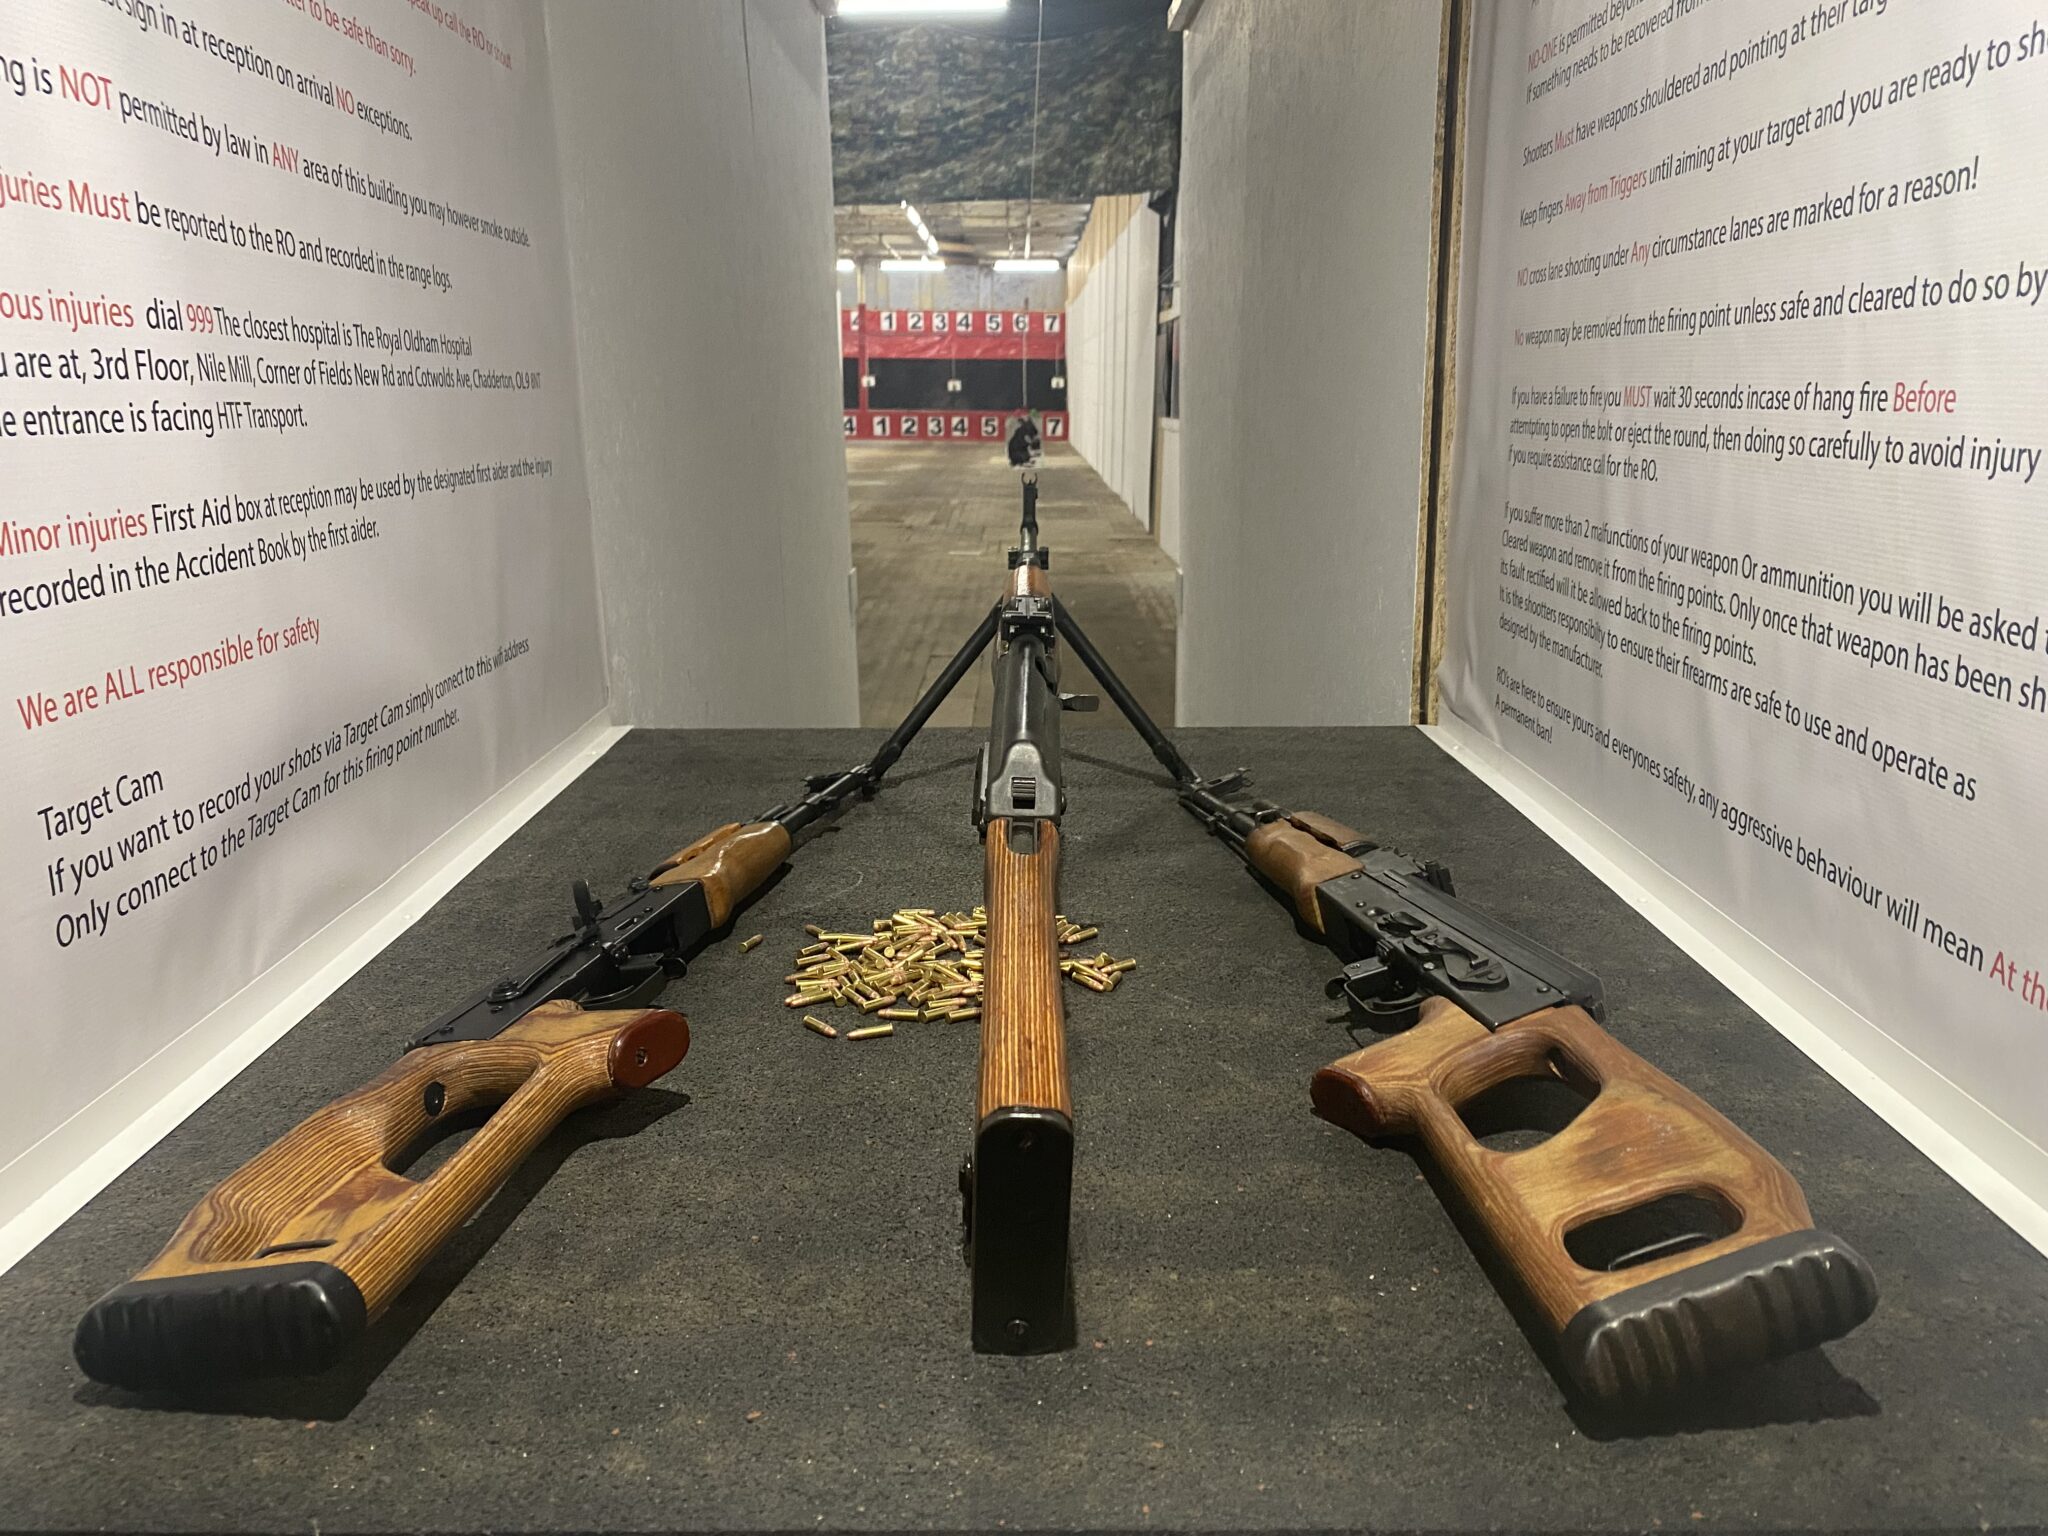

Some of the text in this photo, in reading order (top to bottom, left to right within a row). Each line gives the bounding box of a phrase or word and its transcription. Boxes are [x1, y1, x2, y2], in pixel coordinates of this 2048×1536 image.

[160, 4, 334, 107] in at arrival
[309, 2, 322, 21] to
[365, 26, 388, 58] than
[432, 3, 471, 44] up the
[1528, 9, 1608, 73] NO-ONE permitted
[1600, 3, 1673, 62] to recovered
[1598, 2, 1848, 132] weapons pointing at their
[32, 58, 427, 216] is NOT permitted by law area you
[1564, 40, 2010, 214] Away at and you are ready to
[68, 180, 431, 289] Must be reported to and range
[1548, 156, 1979, 280] lane circumstance marked for a reason!
[48, 289, 374, 348] injuries dial 999 The The
[885, 315, 893, 328] 1
[911, 315, 922, 328] 2
[935, 315, 945, 328] 3
[959, 314, 971, 329] 4
[989, 315, 999, 329] 5
[1016, 314, 1026, 329] 6
[1046, 315, 1058, 329] 7
[1554, 269, 2009, 347] may point and cleared to do so
[15, 348, 472, 390] are at, 3rd Floor, Nile of Ave,
[1602, 380, 1956, 419] you seconds of hang fire Before
[24, 402, 242, 436] entrance HTF
[845, 418, 1061, 434] 4 1 2 3 4 5 7
[1582, 418, 2042, 484] the round, so carefully to avoid injury
[1607, 454, 1658, 482] for RO.
[66, 471, 432, 552] injuries First Aid box at may the
[0, 526, 327, 616] recorded in the the
[1584, 520, 2038, 651] 2 weapon you will be asked
[1552, 641, 1602, 678] manufacturer.
[1558, 547, 2011, 702] and firing once that weapon has been
[1624, 597, 1756, 666] back the firing points.
[17, 628, 279, 730] We are for
[1500, 700, 1552, 744] permanent ban!
[1682, 656, 1976, 801] firearms use and operate as
[38, 771, 163, 840] Target Cam
[48, 668, 464, 896] If you want to record via connect
[56, 760, 363, 947] Only connect to the this
[1612, 738, 2017, 992] everyones behaviour will mean At
